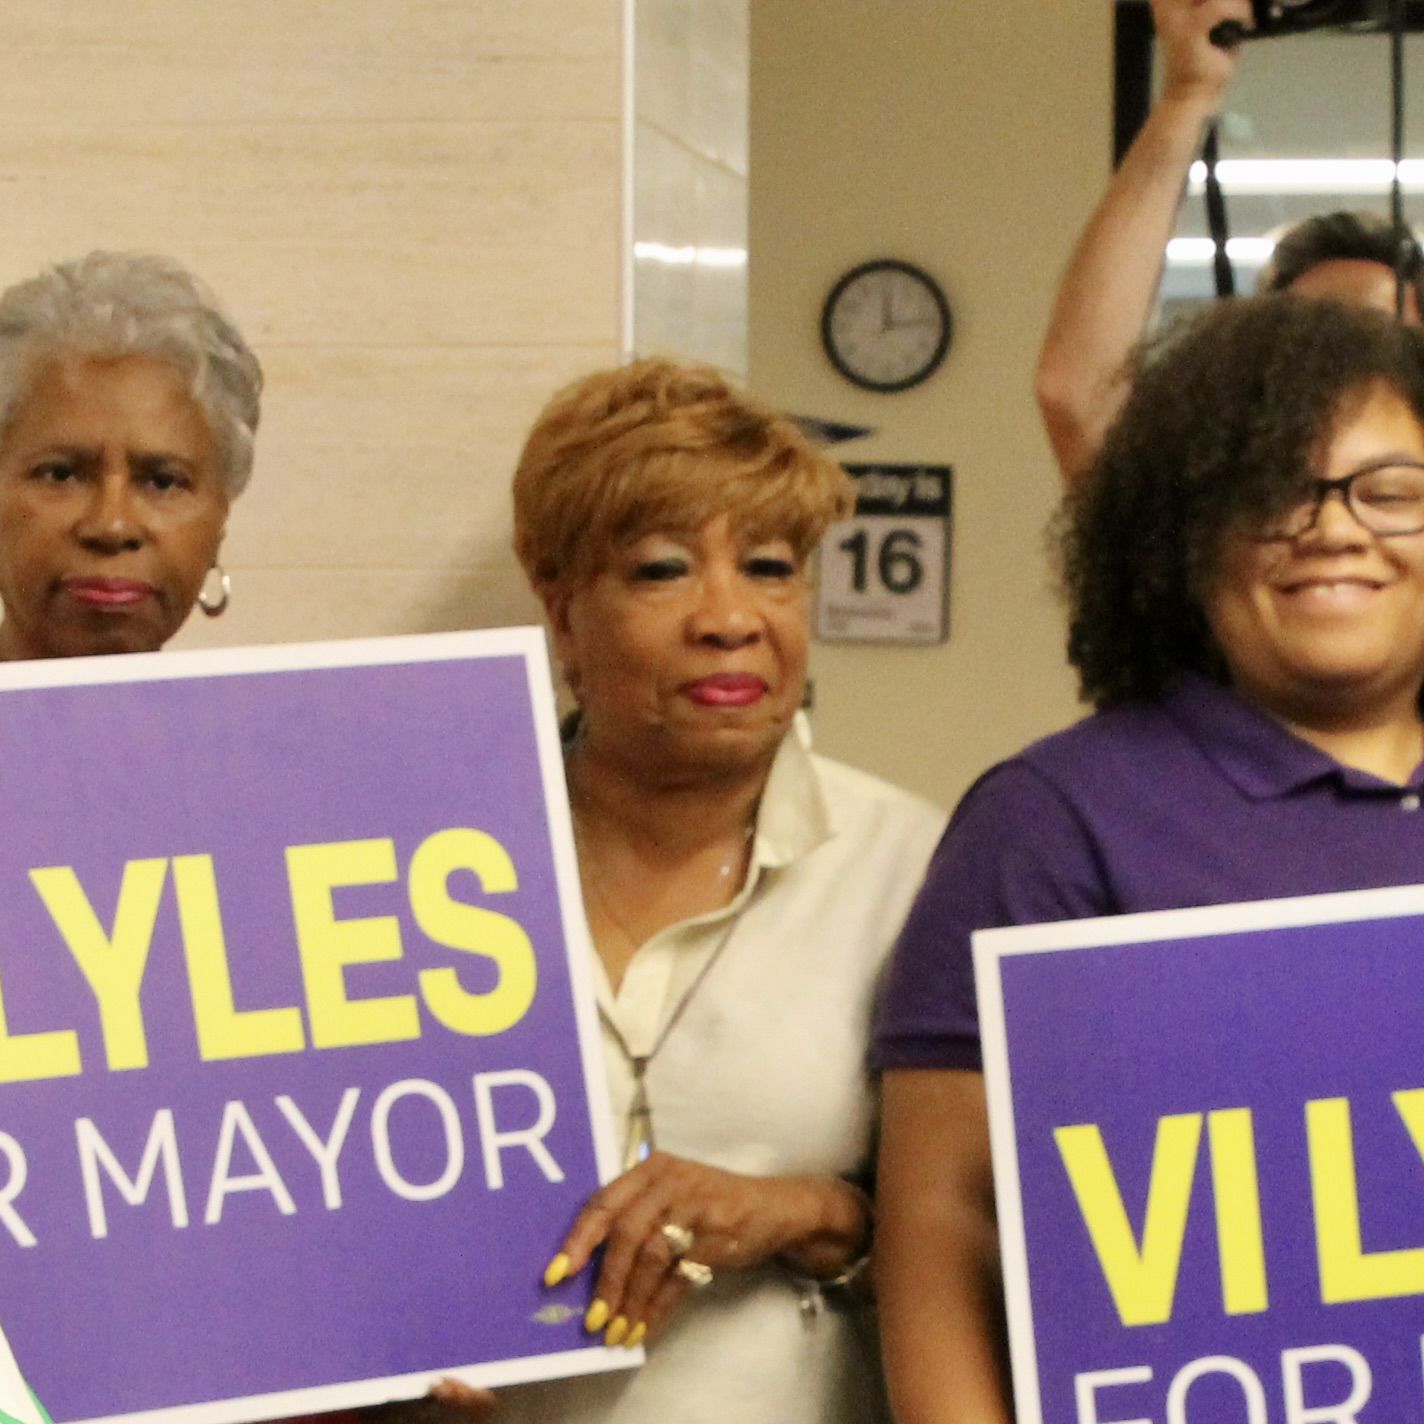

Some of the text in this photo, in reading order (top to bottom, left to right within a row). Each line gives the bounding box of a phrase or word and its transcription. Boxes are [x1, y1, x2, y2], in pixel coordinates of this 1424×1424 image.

[840, 529, 923, 594] 16
[74, 1067, 567, 1241] MAYOR
[1053, 1107, 1269, 1329] VI
